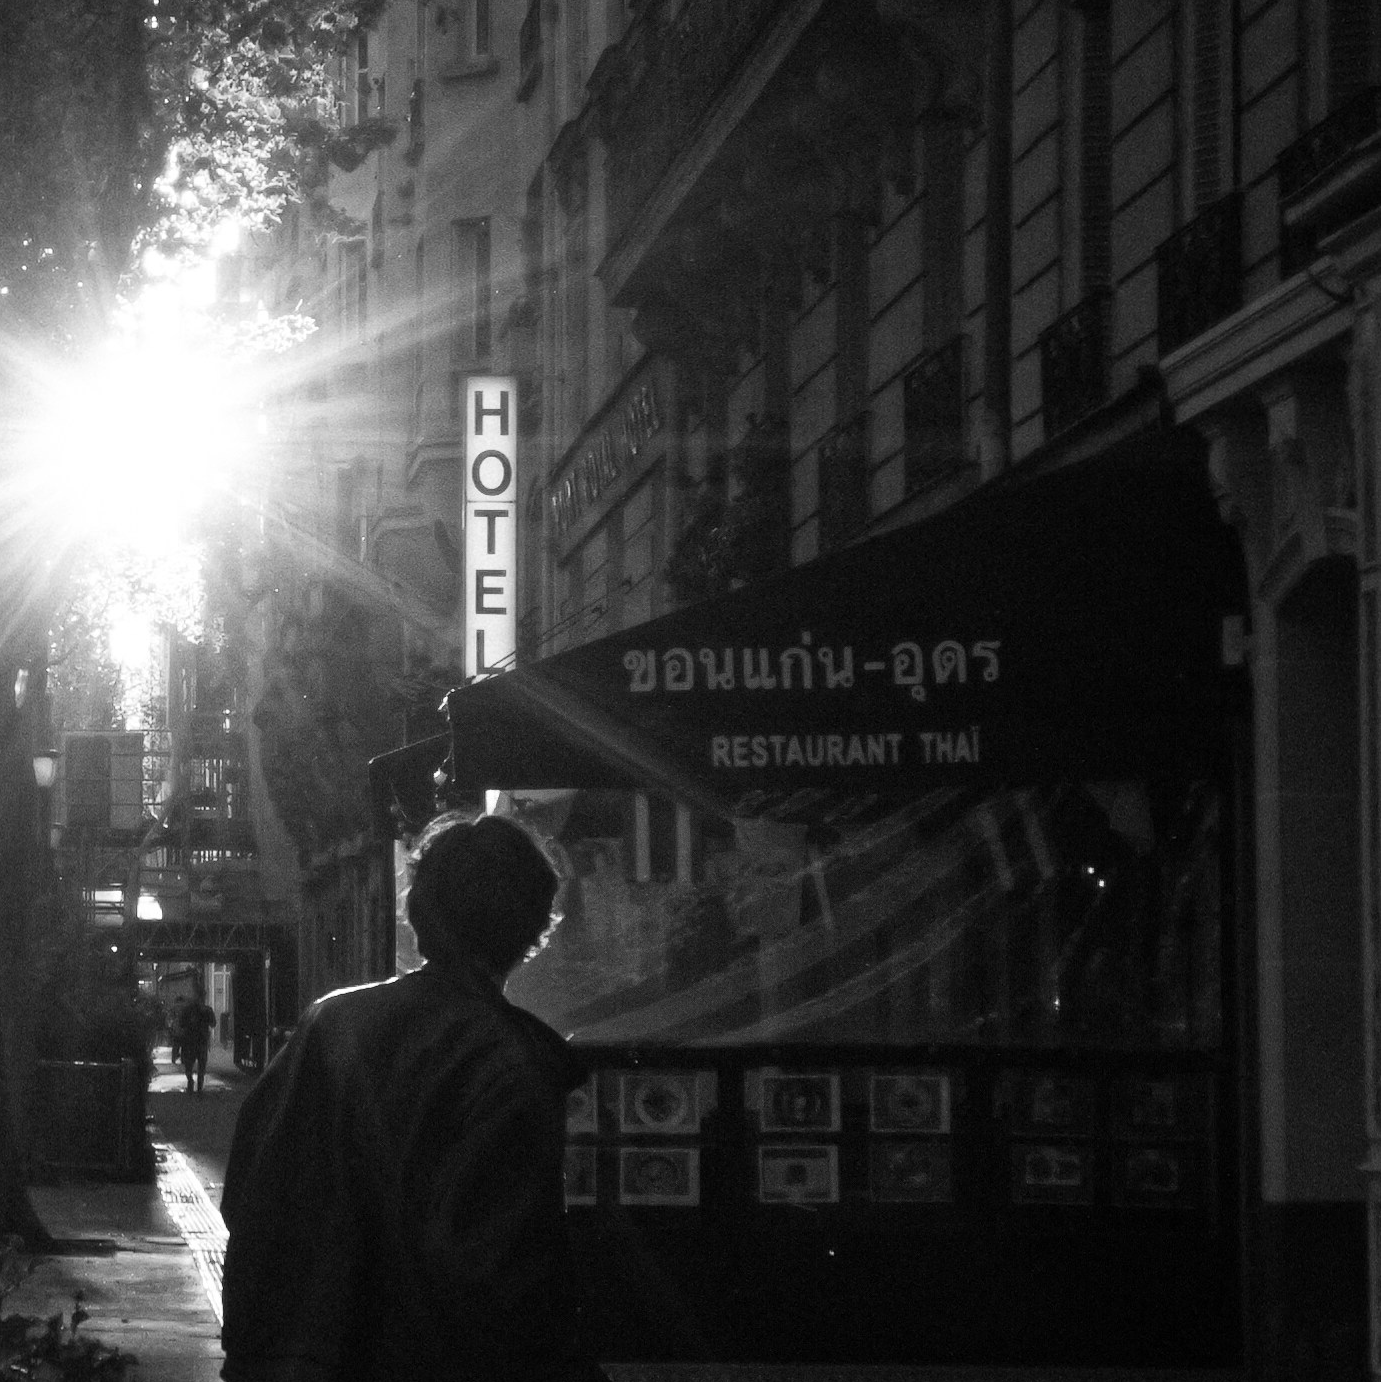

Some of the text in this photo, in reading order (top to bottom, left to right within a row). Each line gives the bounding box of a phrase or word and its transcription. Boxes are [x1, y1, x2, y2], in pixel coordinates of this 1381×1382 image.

[471, 390, 513, 675] HOTEL
[622, 630, 1002, 702] ขอนแก่น-อุดร
[710, 725, 981, 768] RESTAURANT THAÏ
